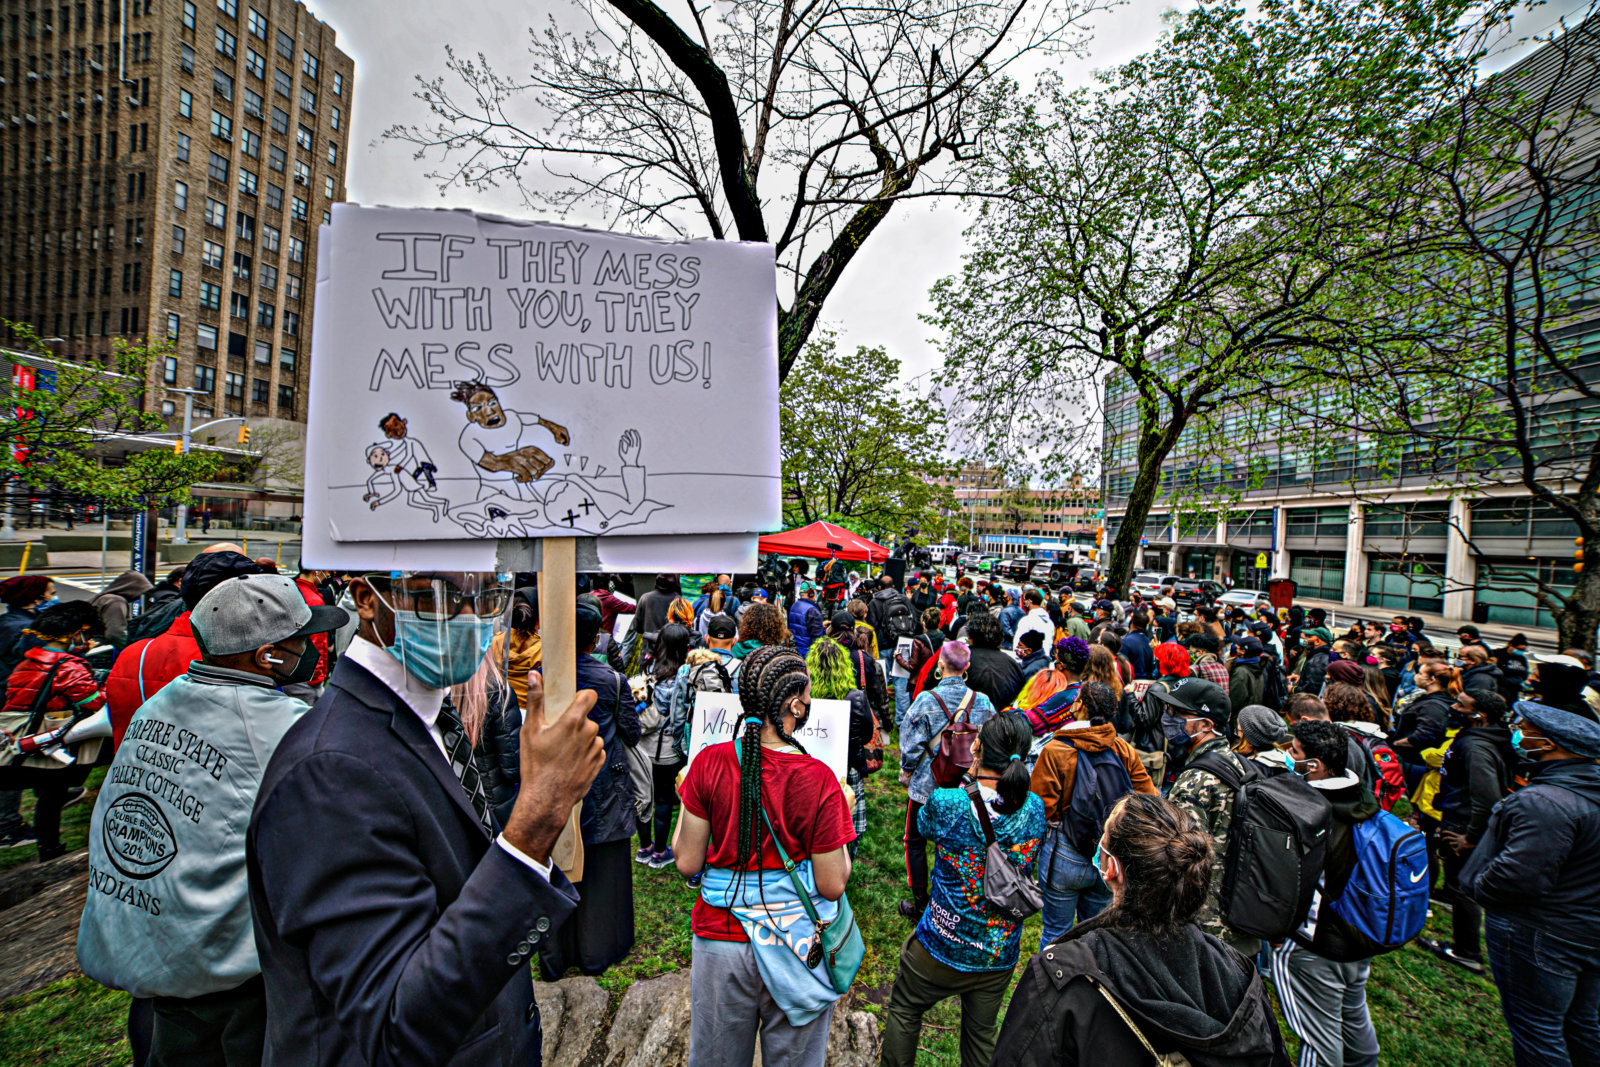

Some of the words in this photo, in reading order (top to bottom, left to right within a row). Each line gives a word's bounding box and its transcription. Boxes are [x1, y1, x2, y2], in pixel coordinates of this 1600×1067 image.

[376, 232, 475, 283] IF
[486, 237, 589, 284] THEY
[594, 249, 701, 290] MESS
[372, 286, 492, 331] WITH
[507, 287, 592, 333] YOU,
[596, 290, 700, 333] THEY
[369, 341, 521, 391] MESS
[535, 341, 633, 389] WITH
[649, 339, 712, 389] US!
[136, 744, 185, 774] CLASSIC
[172, 728, 228, 781] STATE
[145, 772, 204, 824] COTTAGE
[89, 864, 160, 916] NDIANS
[931, 897, 961, 923] WORLD
